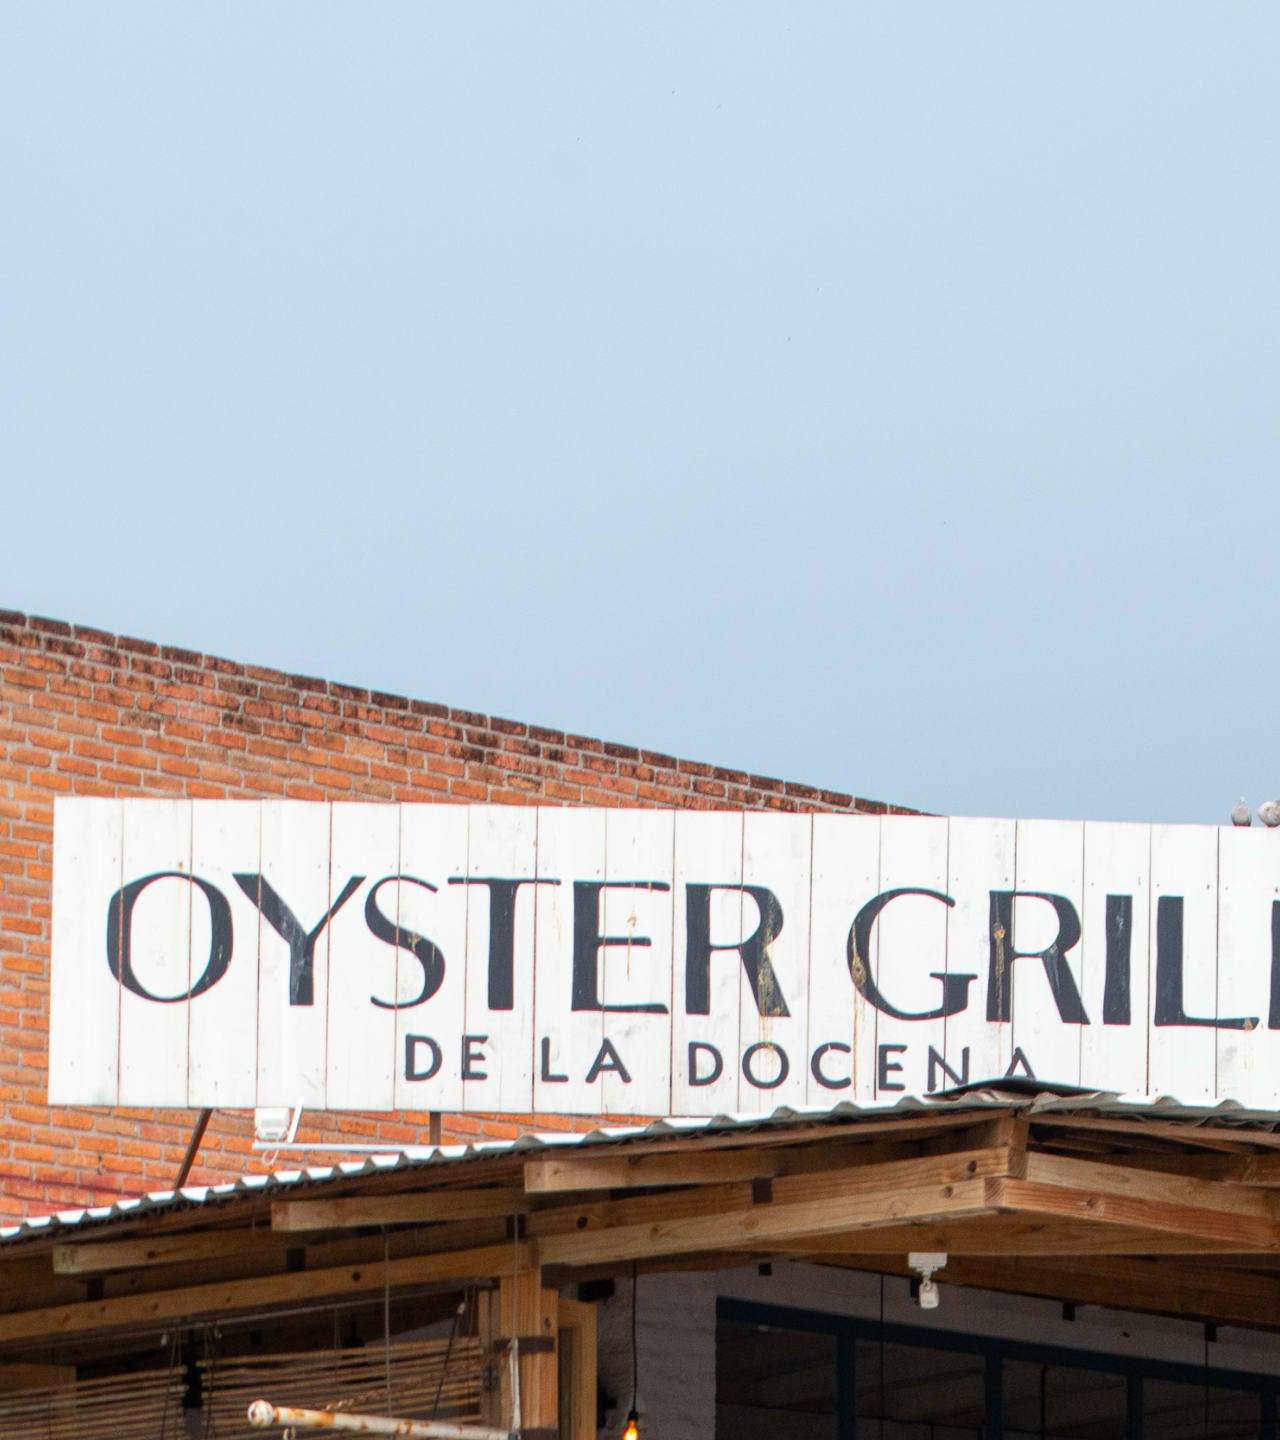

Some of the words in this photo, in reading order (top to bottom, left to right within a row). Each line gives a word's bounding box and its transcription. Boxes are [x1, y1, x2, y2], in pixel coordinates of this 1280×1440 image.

[105, 869, 792, 1018] OYSTER
[404, 1034, 489, 1082] DE
[540, 1036, 632, 1084] LA
[687, 1041, 1039, 1093] DOCENA
